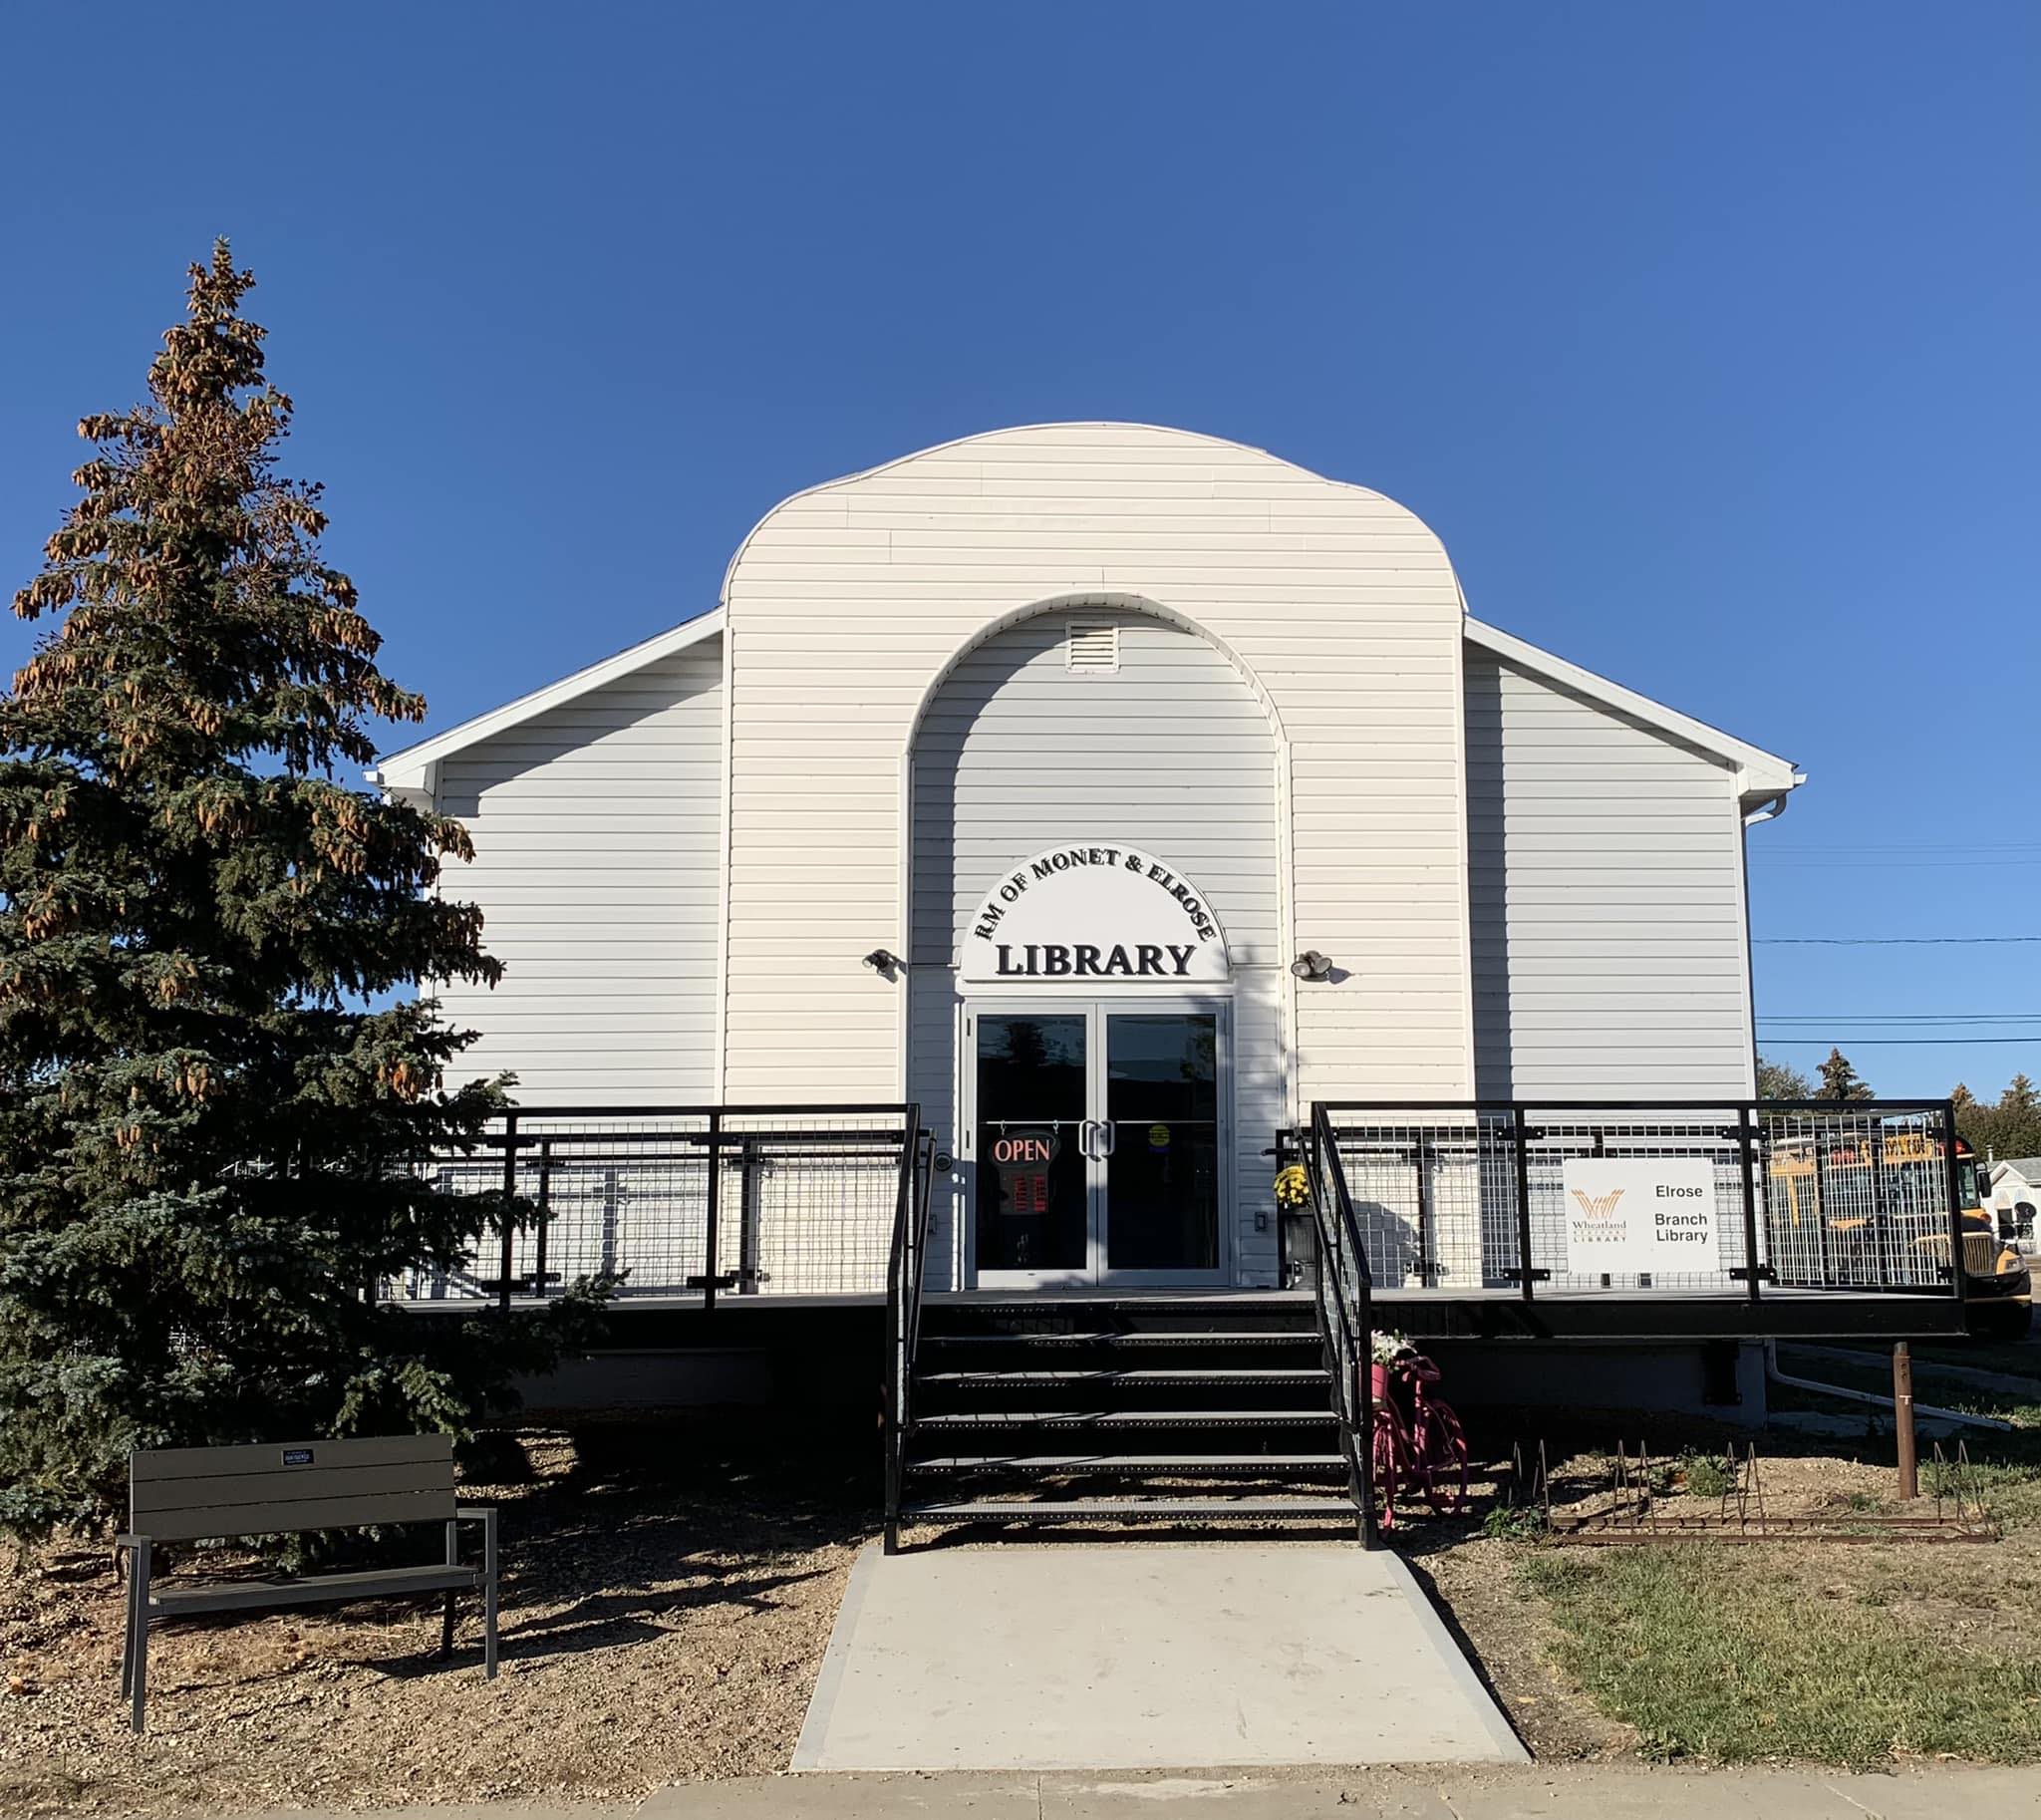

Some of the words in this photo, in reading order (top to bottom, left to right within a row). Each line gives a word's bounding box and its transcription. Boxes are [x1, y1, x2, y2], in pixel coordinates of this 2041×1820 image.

[973, 902, 1006, 942] RM
[1000, 871, 1029, 902] OF
[1029, 847, 1121, 881] MONET
[1124, 853, 1145, 874] &
[1146, 862, 1217, 943] ELROSE
[996, 944, 1198, 976] LIBRARY
[994, 1138, 1050, 1162] OPEN
[1655, 1184, 1703, 1198] Elrose
[1572, 1220, 1627, 1229] Wheatland
[1654, 1212, 1707, 1226] Branch
[1655, 1229, 1708, 1244] Library
